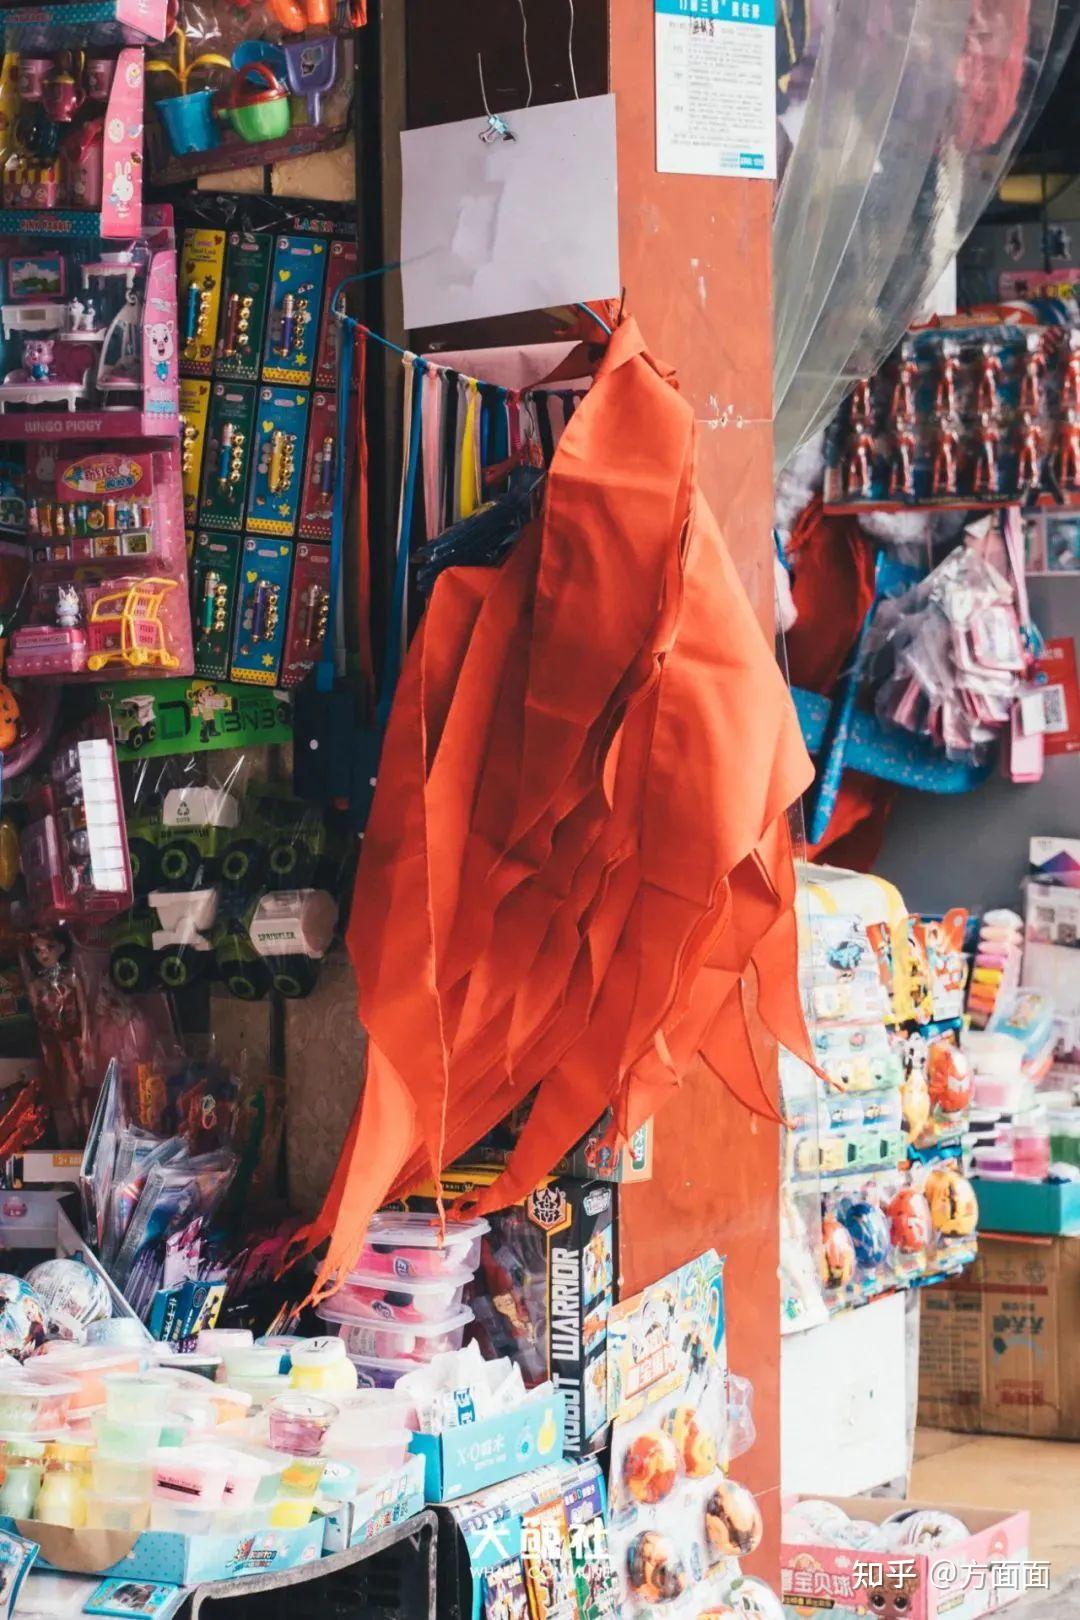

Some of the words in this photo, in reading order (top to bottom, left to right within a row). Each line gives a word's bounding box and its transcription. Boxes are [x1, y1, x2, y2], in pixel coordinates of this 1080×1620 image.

[24, 420, 63, 433] BINGO
[65, 420, 103, 432] PIGGY
[551, 1247, 581, 1362] WARRIOR
